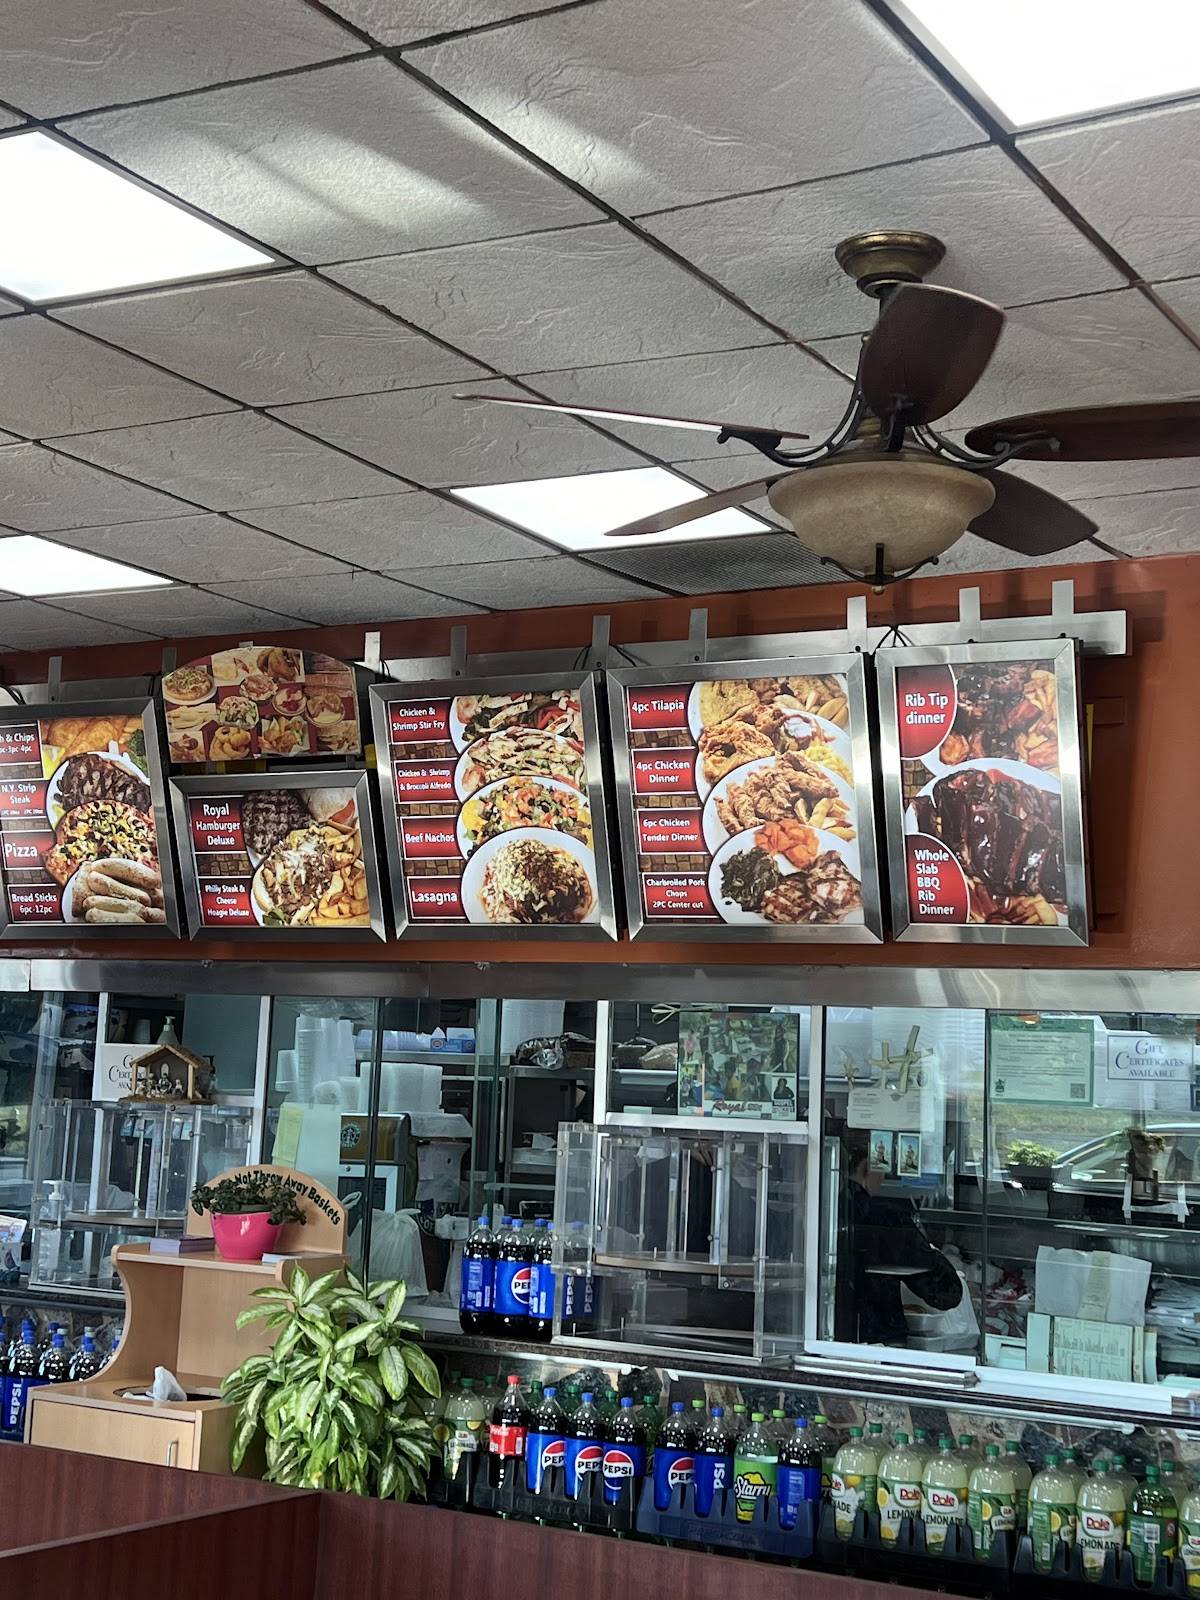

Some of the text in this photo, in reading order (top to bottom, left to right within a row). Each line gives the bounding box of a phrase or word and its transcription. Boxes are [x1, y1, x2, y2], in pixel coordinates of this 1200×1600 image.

[632, 700, 685, 714] 4pc Tilapia
[905, 693, 949, 709] Rib Tip
[399, 707, 436, 717] Chicken &
[905, 711, 946, 725] dinner
[393, 720, 445, 731] Shrimp Stir Fry
[6, 734, 13, 742] &
[14, 732, 35, 744] Chips
[636, 760, 690, 773] 4pc Chicken
[398, 769, 421, 777] Chicken
[429, 769, 450, 777] Shrimp
[649, 773, 680, 783] Dinner
[18, 783, 37, 795] Strip
[406, 783, 429, 791] Broccoli
[430, 782, 452, 790] Alfredo
[10, 795, 31, 804] Steak
[203, 803, 230, 819] Royal
[196, 821, 241, 833] Hamburger
[643, 818, 690, 830] 6pc Chicken
[207, 836, 235, 846] Deluxe
[405, 832, 455, 843] Beef Nachos
[642, 832, 698, 842] Tender Dinner
[5, 844, 38, 857] Pizza
[915, 849, 950, 862] Whole
[916, 863, 939, 875] Slab
[646, 878, 706, 887] Charbroiled Pork
[917, 877, 941, 890] BBQ
[205, 884, 246, 895] Philly Steak &
[665, 889, 688, 899] Chops
[12, 892, 57, 903] Bread Sticks
[216, 897, 238, 905] Cheese
[411, 890, 458, 905] Lasagna
[918, 890, 935, 902] Rib
[652, 900, 704, 909] 2PC Center cut
[919, 903, 955, 916] Dinner
[207, 908, 250, 918] Hoagie Deluxe
[1128, 1069, 1176, 1078] AVAILABLE
[253, 1170, 284, 1186] Throw
[284, 1174, 309, 1195] Away
[308, 1186, 341, 1226] Baskets
[10, 1383, 22, 1425] PEPSI
[544, 1456, 565, 1464] PEP
[671, 1472, 694, 1481] PEP
[900, 1488, 921, 1501] Dole
[932, 1493, 956, 1507] Dole
[1086, 1516, 1110, 1531] Dole
